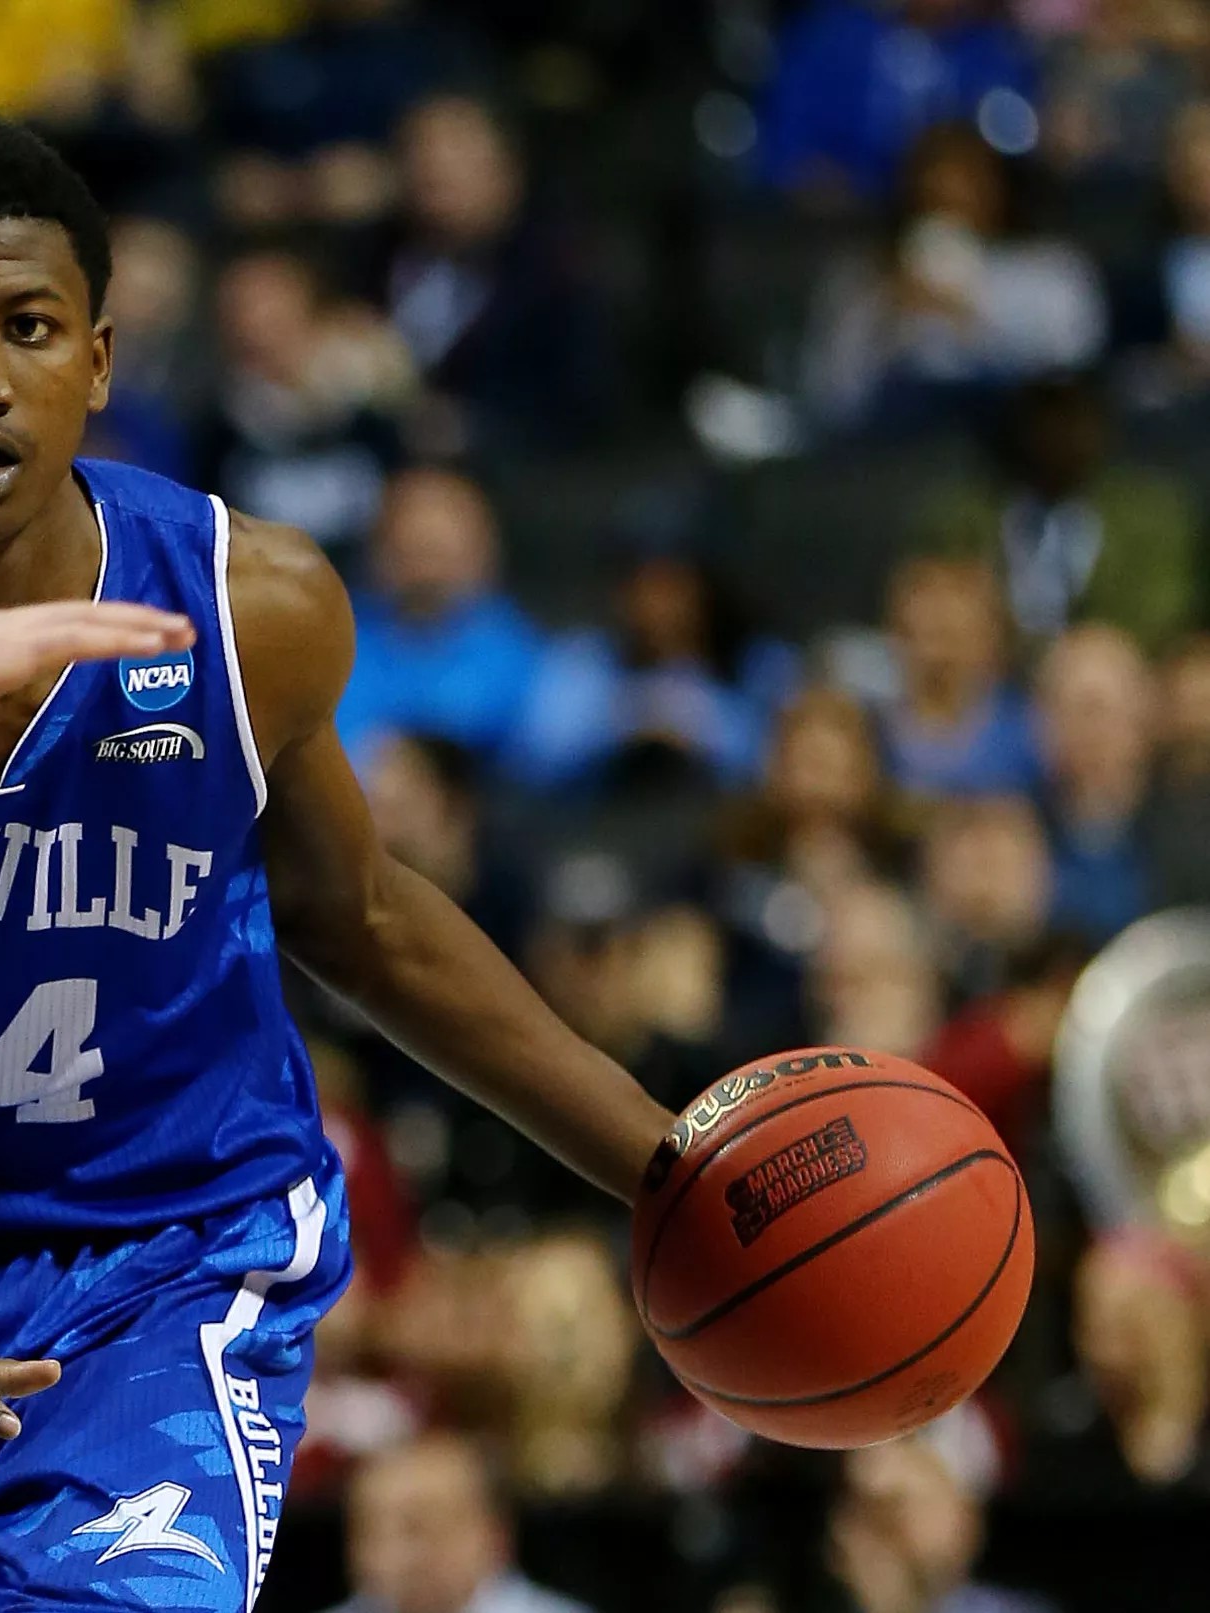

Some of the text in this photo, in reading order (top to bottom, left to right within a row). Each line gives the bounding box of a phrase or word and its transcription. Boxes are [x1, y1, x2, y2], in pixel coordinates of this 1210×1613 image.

[127, 664, 191, 692] NCAA
[97, 741, 127, 758] BIG
[127, 736, 183, 759] SOUTH
[746, 1136, 819, 1196] MARCH
[765, 1142, 865, 1210] MADNESS
